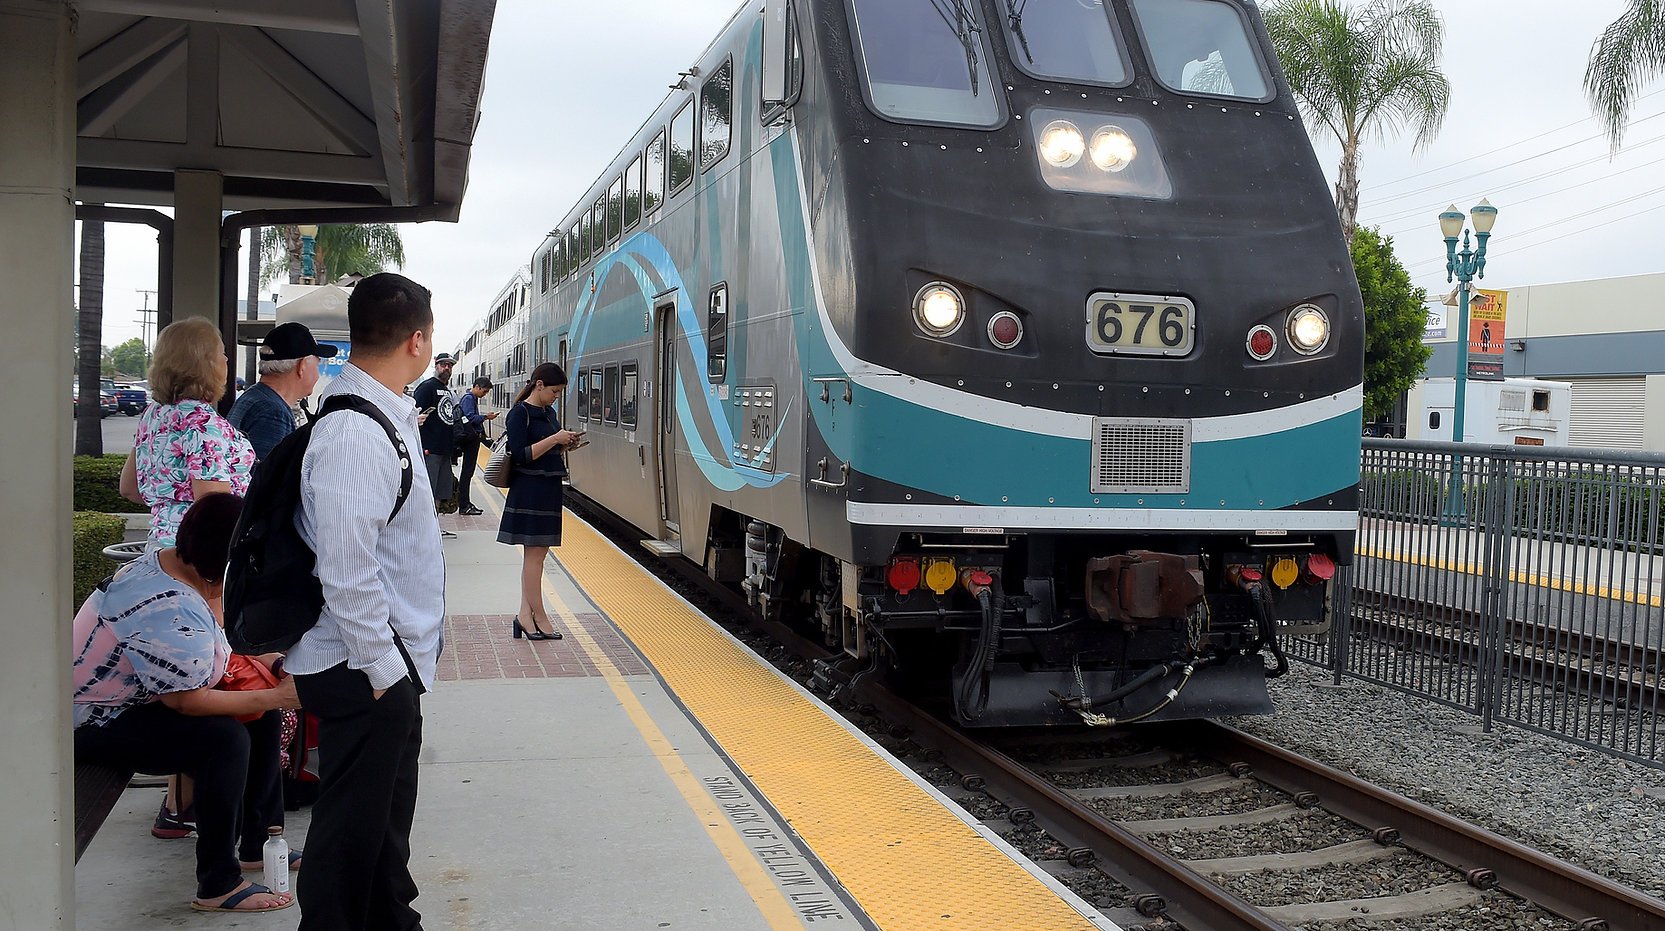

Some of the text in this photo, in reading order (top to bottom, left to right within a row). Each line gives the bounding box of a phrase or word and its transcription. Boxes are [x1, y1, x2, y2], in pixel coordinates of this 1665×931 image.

[1097, 302, 1184, 347] 676
[756, 414, 770, 440] 676
[703, 776, 844, 922] STAND BACK OF YELLOW LINE
